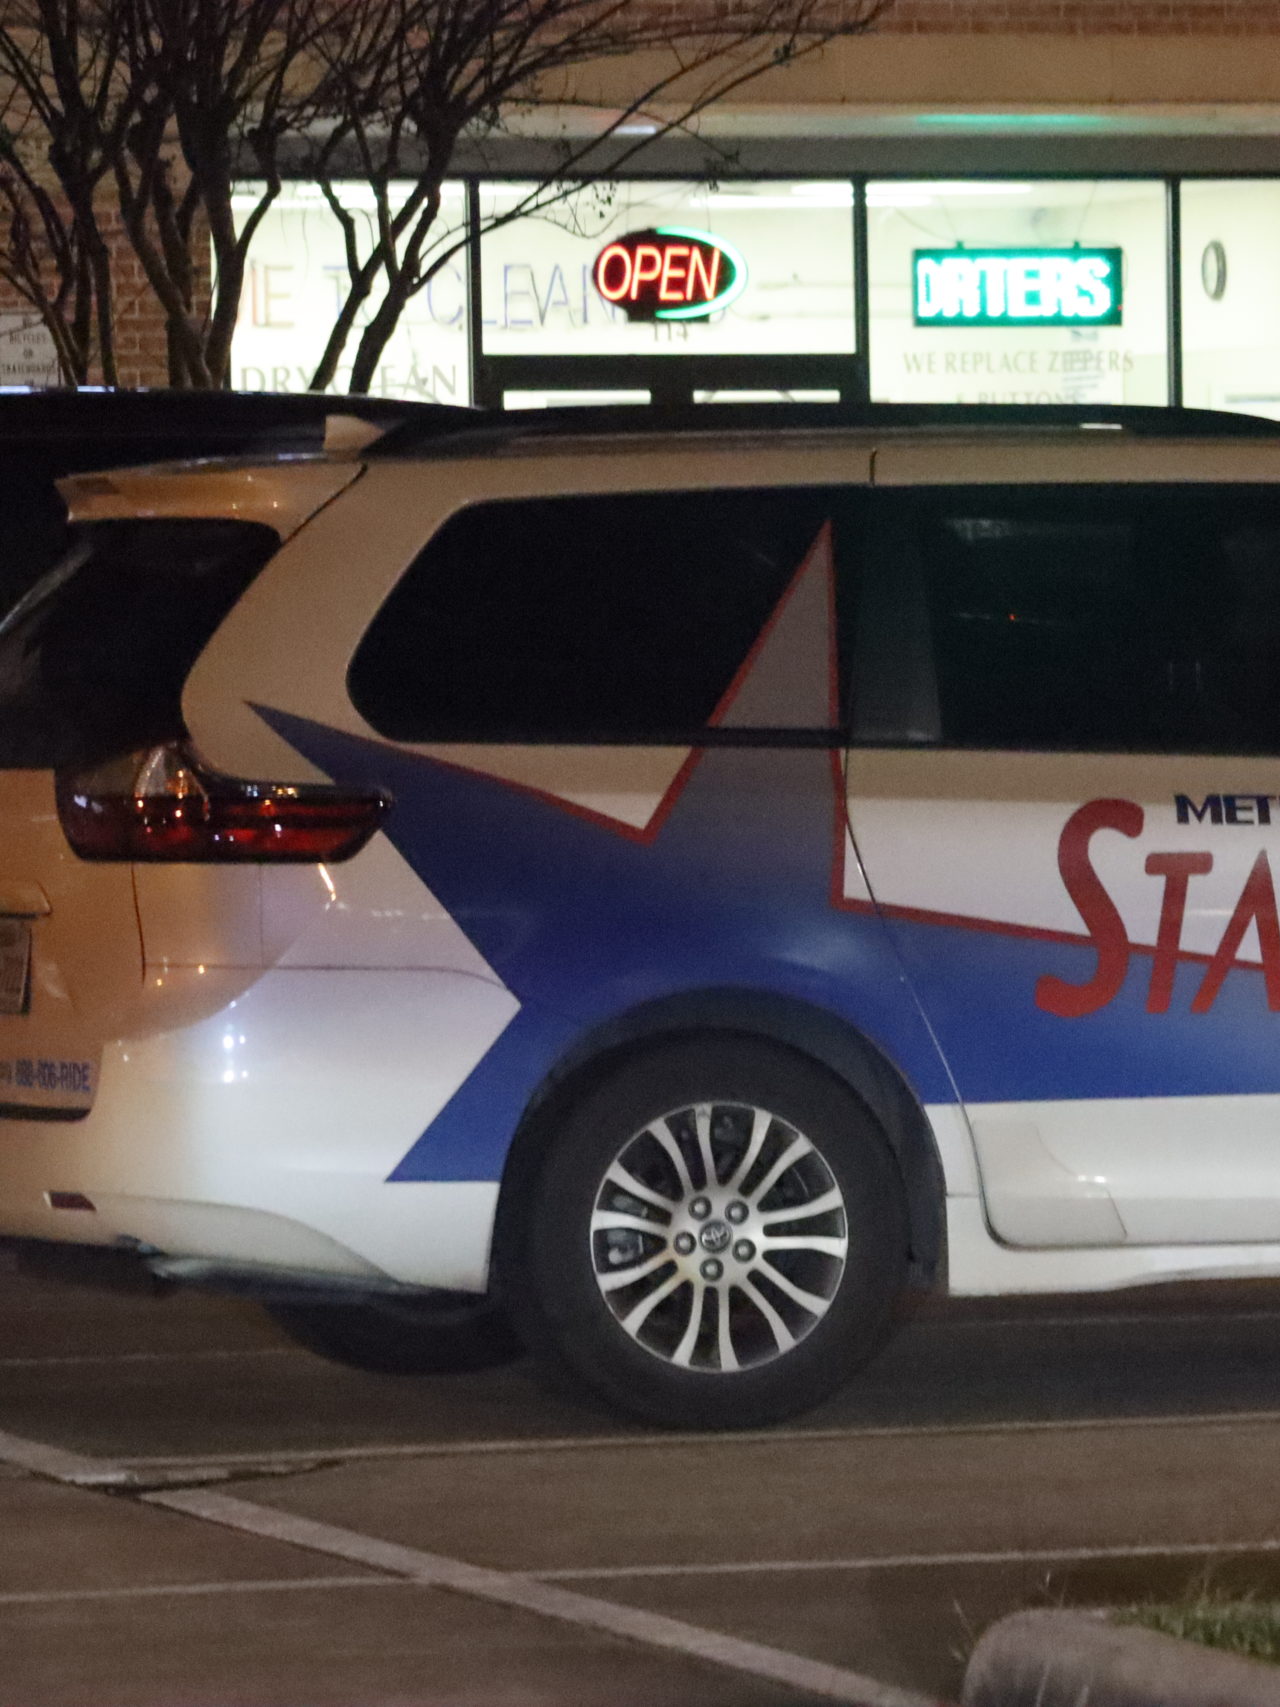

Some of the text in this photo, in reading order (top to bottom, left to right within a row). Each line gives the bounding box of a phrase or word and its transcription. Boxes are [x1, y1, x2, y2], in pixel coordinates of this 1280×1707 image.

[597, 244, 721, 302] OPEN
[903, 348, 1136, 374] WE REPLACE ZIPPERS
[240, 364, 458, 398] DRY CEAN
